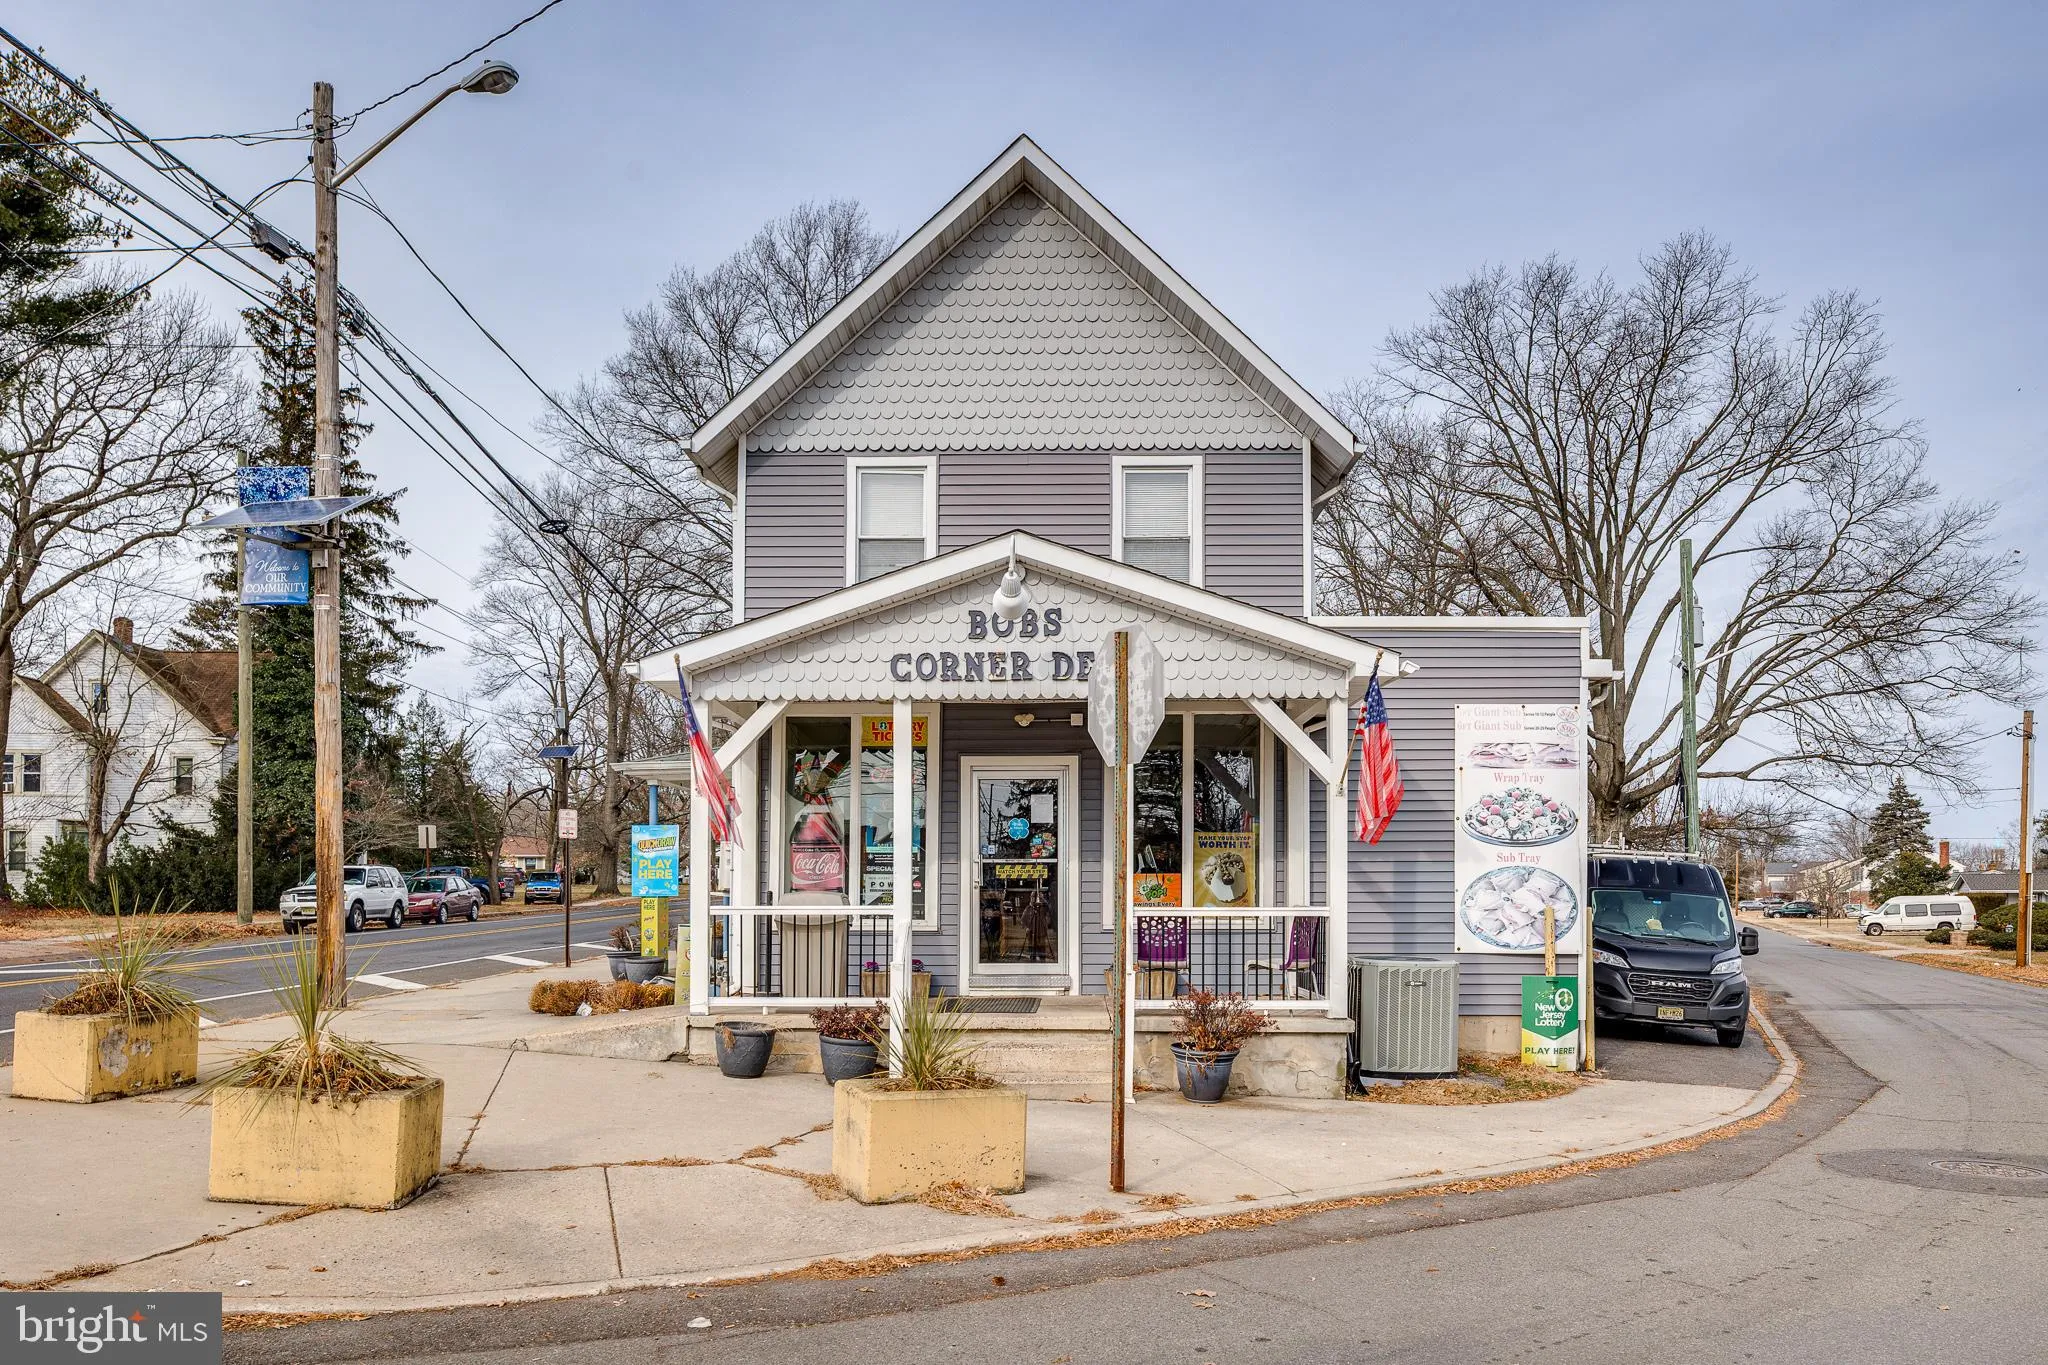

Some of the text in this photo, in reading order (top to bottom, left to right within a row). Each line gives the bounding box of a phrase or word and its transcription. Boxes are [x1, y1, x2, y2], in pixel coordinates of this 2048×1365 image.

[255, 560, 299, 572] Welcome to
[265, 572, 288, 582] OUR
[245, 582, 306, 593] COMMUNITY
[968, 607, 1062, 639] BOBS
[890, 651, 1032, 682] CORNER
[872, 722, 924, 732] LOTRY
[1474, 720, 1500, 730] Giant
[1503, 720, 1522, 730] Sub
[873, 732, 922, 741] TICS
[1494, 772, 1544, 784] Wrap Tray
[793, 853, 840, 874] Coca-Cola
[1497, 853, 1541, 864] Sub Tray
[639, 859, 673, 869] PLAY
[638, 869, 673, 879] HERE
[1652, 980, 1691, 988] RAM
[1535, 1002, 1556, 1011] New
[1540, 1010, 1566, 1020] Jersey
[1535, 1018, 1566, 1028] Lottery
[1554, 1047, 1575, 1055] HERE!
